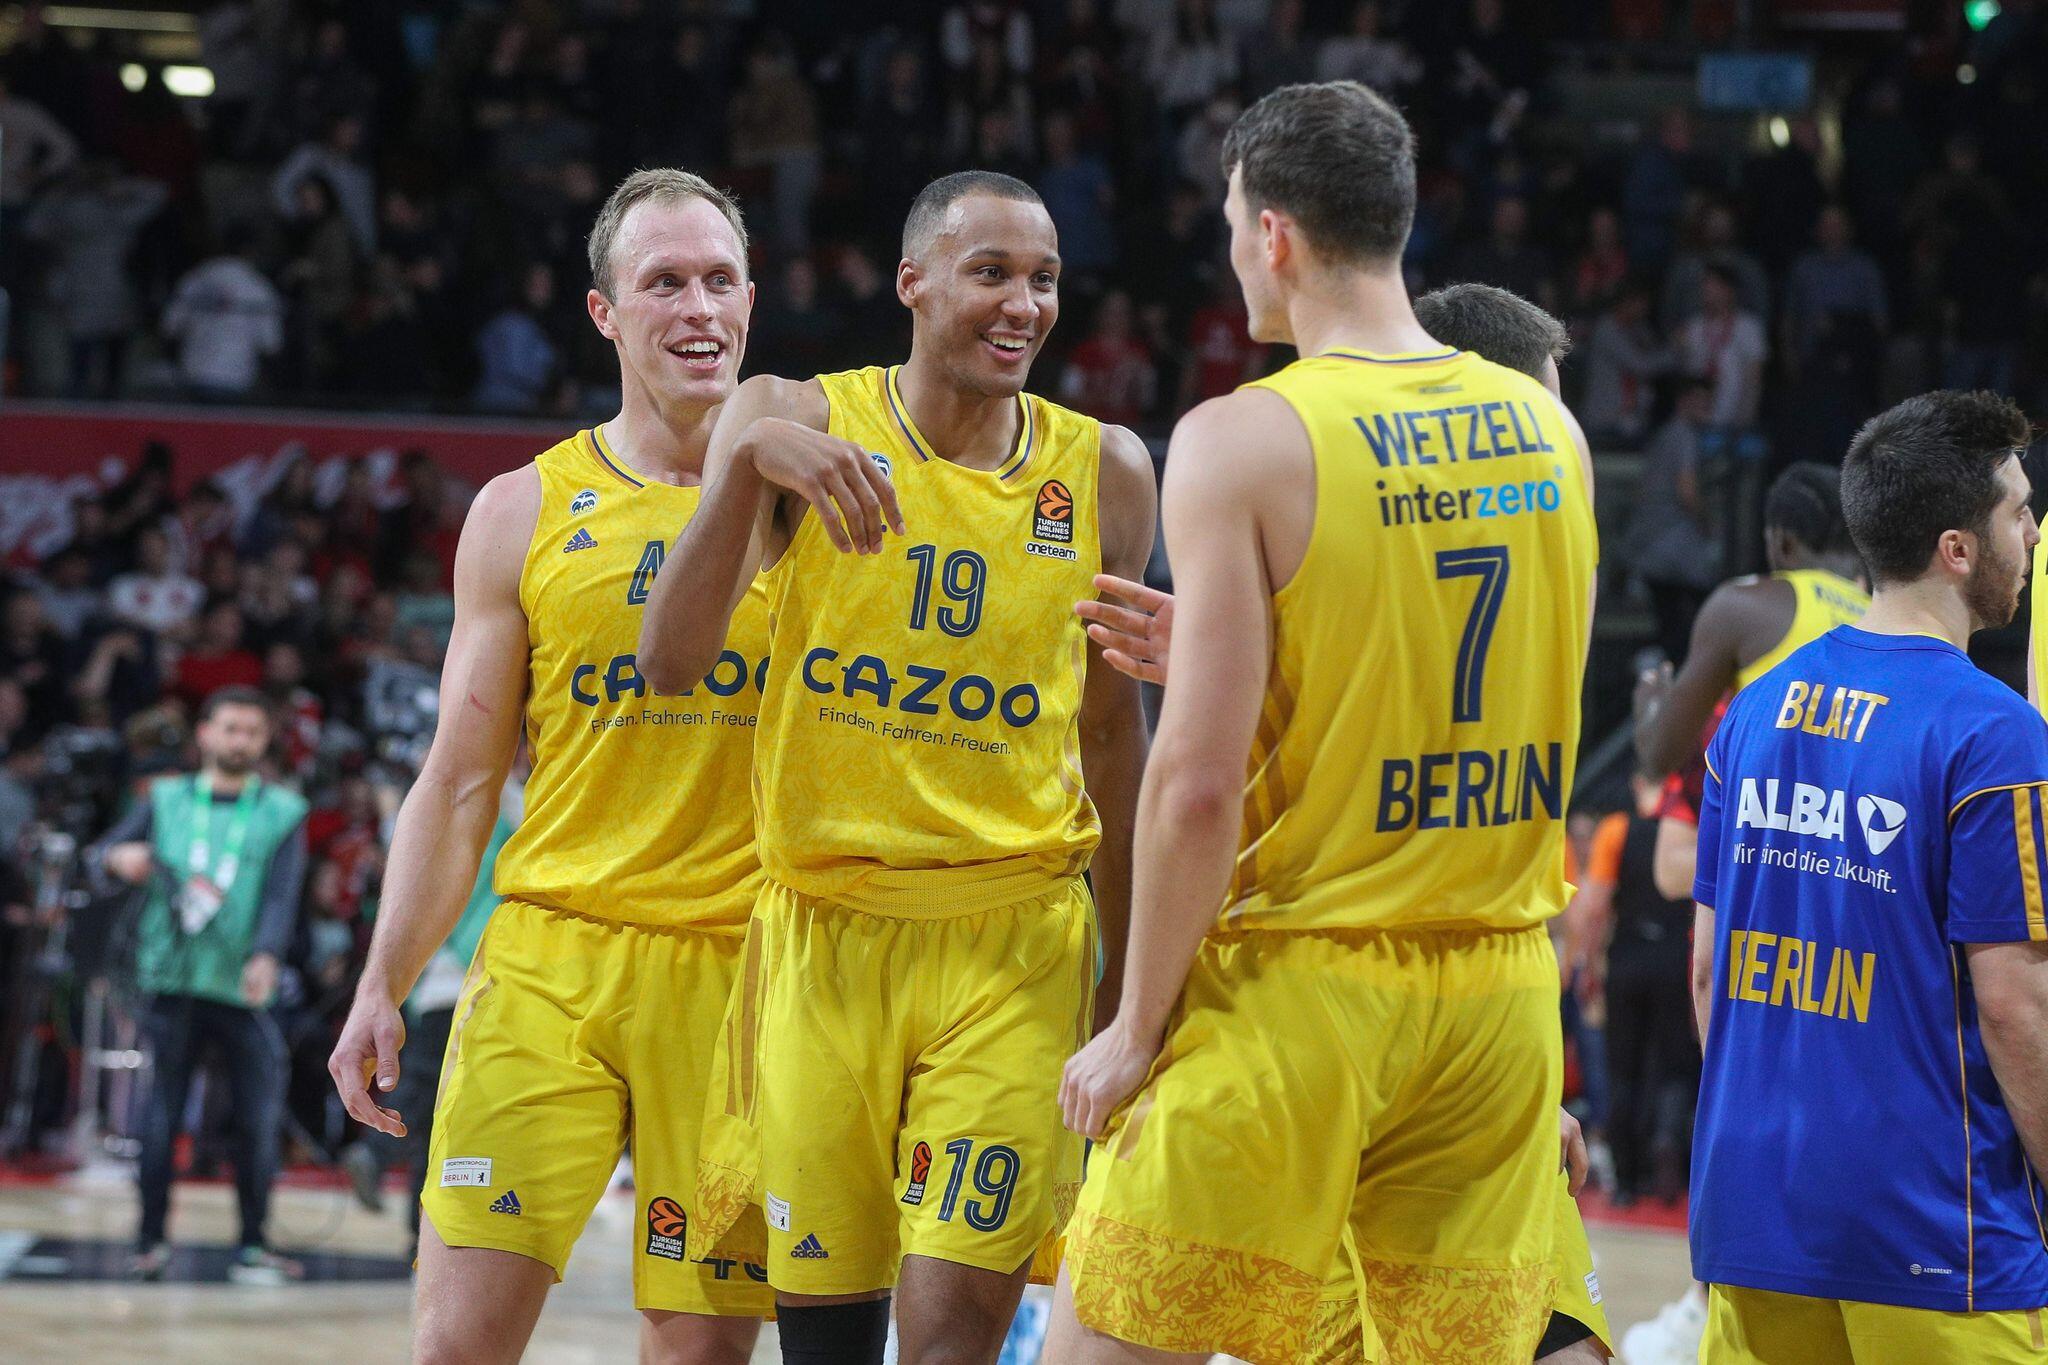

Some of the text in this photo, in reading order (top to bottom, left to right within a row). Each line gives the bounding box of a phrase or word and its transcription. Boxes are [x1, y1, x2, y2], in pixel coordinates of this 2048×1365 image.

[1353, 401, 1555, 468] WETZELL
[563, 540, 598, 553] adidas
[1036, 525, 1069, 535] AIRLINES
[1037, 518, 1070, 529] TURKISH
[906, 544, 987, 637] 19
[1435, 545, 1510, 723] 7
[571, 649, 770, 707] CAO
[802, 647, 1041, 727] CAZOO
[591, 709, 757, 734] Fien. Fahren. Freue
[819, 707, 1011, 755] Finden. Fahren. Freuen.
[1775, 680, 1890, 743] BLATT
[1375, 742, 1562, 833] BERLIN
[1736, 778, 1845, 842] ALBA
[1800, 851, 1830, 875] die
[444, 1174, 469, 1182] BERLIN
[938, 1137, 1021, 1232] 19
[650, 1241, 682, 1253] AIRLINES
[651, 1234, 682, 1247] TURKISH
